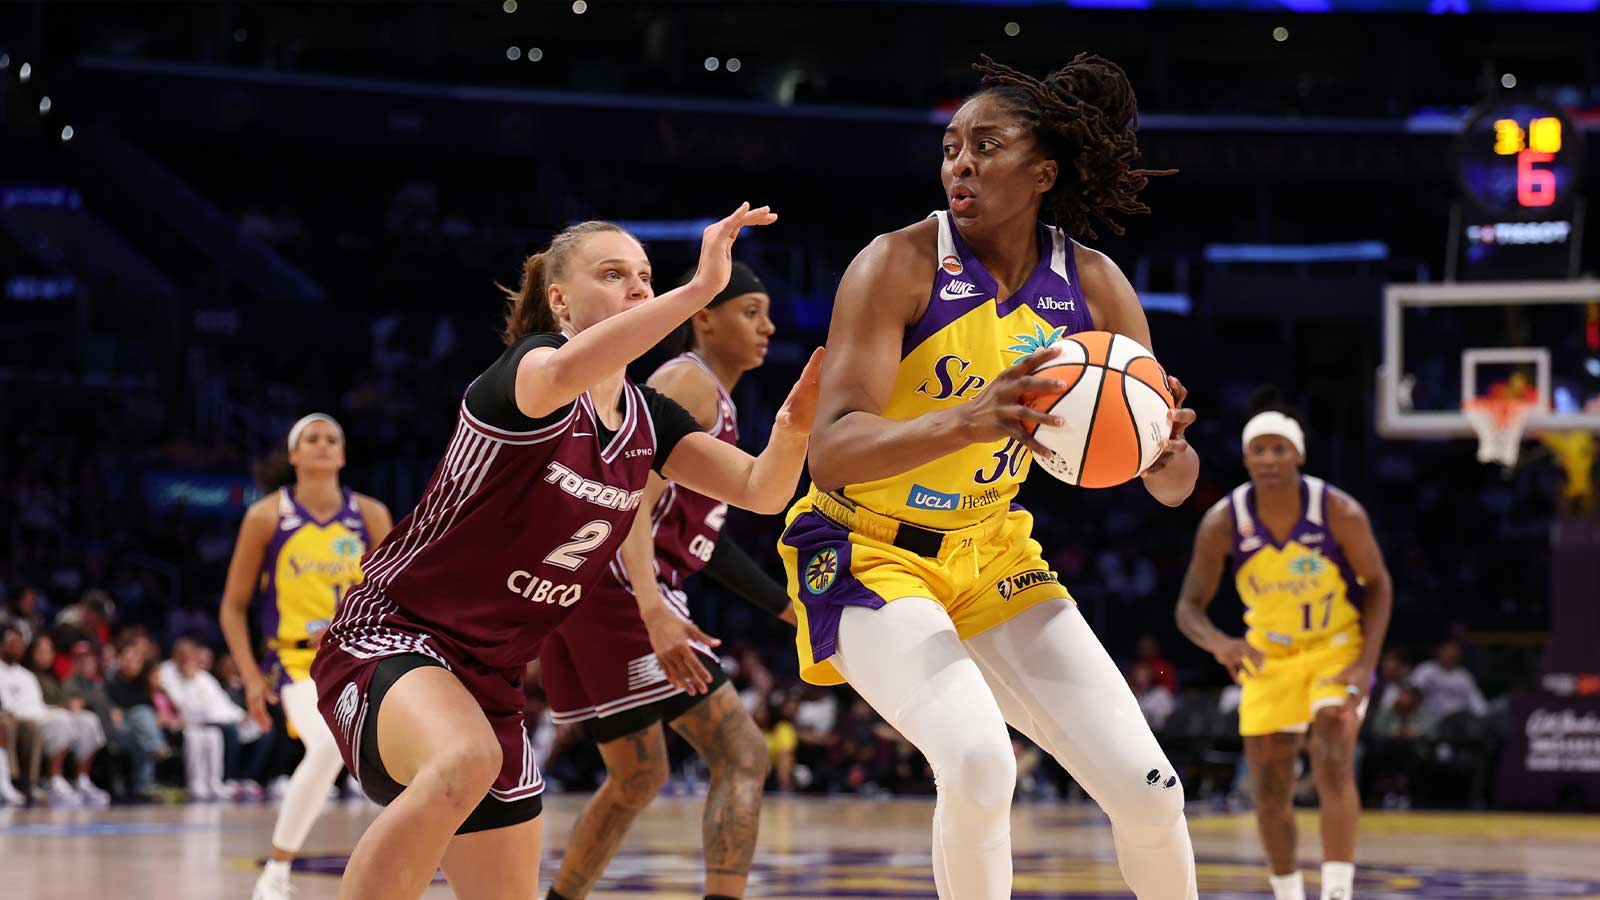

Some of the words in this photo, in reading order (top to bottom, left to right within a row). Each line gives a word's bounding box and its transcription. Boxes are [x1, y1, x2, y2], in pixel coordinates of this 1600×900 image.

[1517, 150, 1555, 206] 6
[946, 279, 975, 294] NIKE
[1036, 296, 1075, 311] Albert
[624, 448, 653, 459] SEPHO
[914, 491, 951, 509] UCLA
[961, 486, 1000, 510] Health
[542, 519, 613, 572] 2
[1013, 570, 1057, 590] WNBA
[1299, 591, 1334, 631] 17
